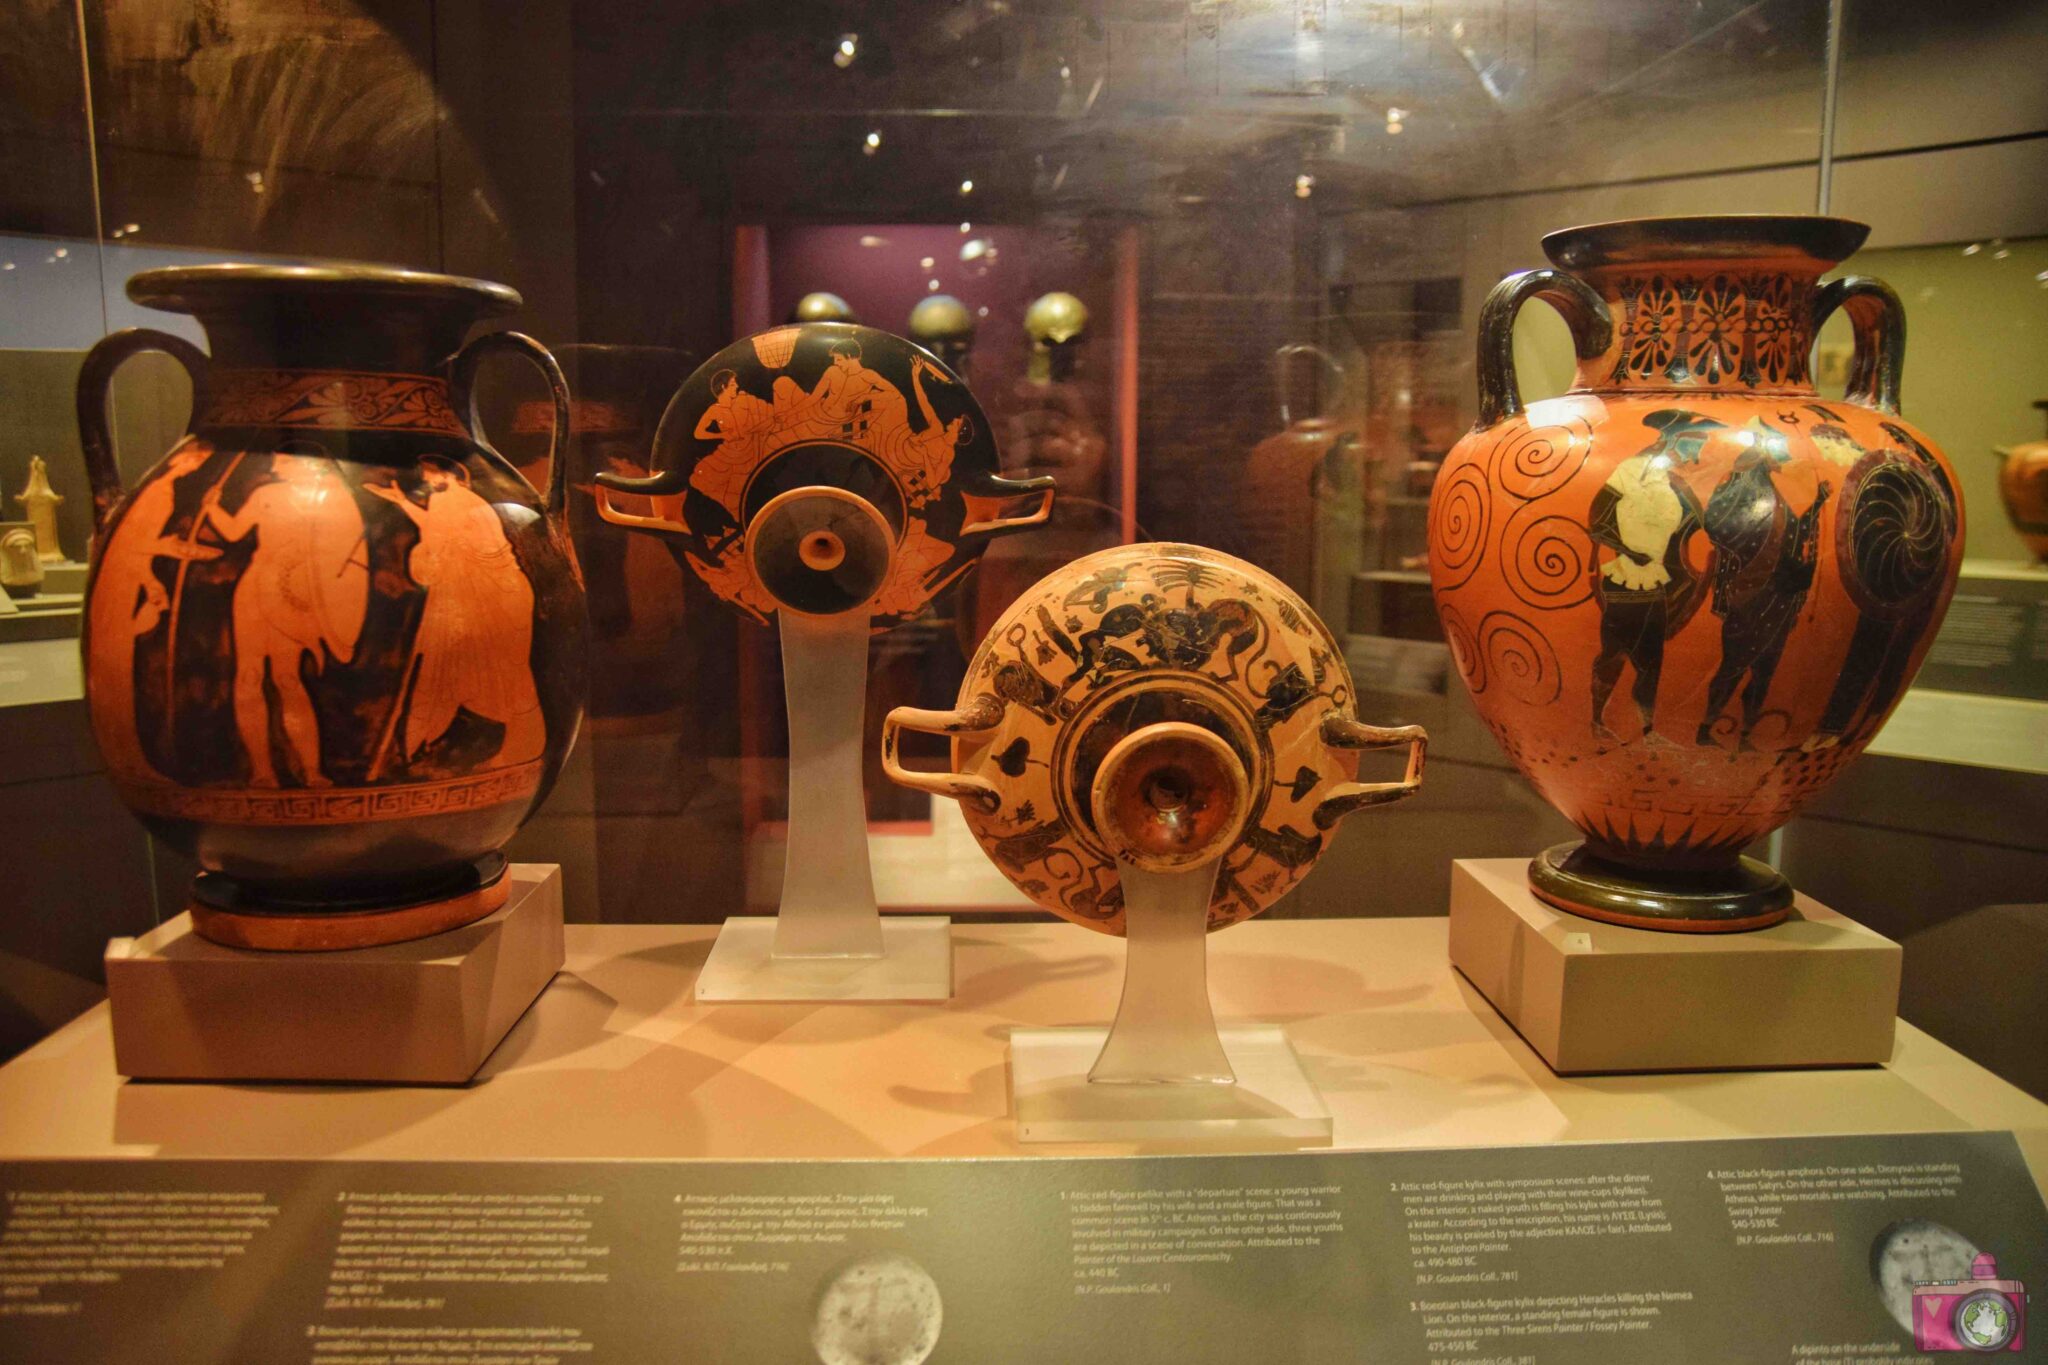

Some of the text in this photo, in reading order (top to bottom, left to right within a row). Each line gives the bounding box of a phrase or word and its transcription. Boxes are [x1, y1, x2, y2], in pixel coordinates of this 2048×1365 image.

[1400, 1181, 1420, 1190] Attic
[1421, 1179, 1464, 1192] red-figure
[1464, 1178, 1484, 1190] kylix
[1485, 1177, 1505, 1187] with
[1505, 1176, 1554, 1189] symposium
[1586, 1174, 1606, 1184] after
[1607, 1173, 1622, 1183] the
[1622, 1172, 1652, 1184] dinner,
[1280, 1187, 1309, 1197] young
[1310, 1184, 1341, 1194] warrior
[1439, 1191, 1475, 1203] drinking
[1475, 1190, 1493, 1200] and
[1493, 1189, 1526, 1202] playing
[1526, 1188, 1546, 1198] with
[1546, 1188, 1567, 1198] their
[1567, 1187, 1611, 1199] wine-cups
[1222, 1199, 1245, 1209] male
[1275, 1198, 1295, 1208] That
[1405, 1206, 1418, 1215] On
[1419, 1205, 1434, 1215] the
[1477, 1203, 1504, 1213] naked
[1504, 1202, 1530, 1214] youth
[1531, 1202, 1539, 1211] is
[1539, 1200, 1564, 1213] filling
[1564, 1200, 1578, 1209] his
[1578, 1199, 1598, 1211] kylix
[1599, 1198, 1618, 1208] with
[1619, 1198, 1640, 1207] wine
[1641, 1197, 1662, 1207] from
[1232, 1211, 1247, 1221] the
[1248, 1211, 1265, 1223] city
[1284, 1209, 1341, 1222] continuously
[1728, 1206, 1785, 1217] Swing Painter.
[1413, 1217, 1442, 1227] krater.
[1442, 1216, 1487, 1229] According
[1487, 1216, 1498, 1225] to
[1498, 1215, 1514, 1225] the
[1514, 1214, 1562, 1226] inscription,
[1563, 1213, 1576, 1222] his
[1576, 1214, 1601, 1222] name
[1602, 1212, 1610, 1221] is
[1732, 1218, 1779, 1228] 540-530 BC
[1208, 1225, 1223, 1234] On
[1224, 1224, 1240, 1234] the
[1240, 1224, 1265, 1234] other
[1287, 1223, 1312, 1233] three
[1312, 1222, 1343, 1234] youths
[1409, 1231, 1422, 1241] his
[1423, 1230, 1454, 1243] beauty
[1454, 1230, 1462, 1239] is
[1463, 1229, 1495, 1241] praised
[1496, 1228, 1508, 1240] by
[1508, 1227, 1524, 1237] the
[1525, 1226, 1564, 1239] adjective
[1627, 1222, 1672, 1233] Attributed
[1246, 1236, 1292, 1246] Attributed
[1293, 1236, 1304, 1245] to
[1305, 1235, 1321, 1245] the
[1412, 1242, 1511, 1255] to the Antiphon Painter.
[1116, 1253, 1131, 1263] the
[1427, 1257, 1463, 1266] 490-480
[1463, 1256, 1477, 1266] BC
[1514, 1296, 1535, 1308] kylix
[1578, 1293, 1616, 1303] Heracles
[1617, 1292, 1644, 1304] killing
[1645, 1291, 1660, 1301] the
[1424, 1314, 1445, 1323] Lion.
[1446, 1313, 1460, 1323] On
[1461, 1312, 1477, 1322] the
[1521, 1309, 1560, 1322] standing
[1561, 1307, 1592, 1318] female
[1592, 1306, 1619, 1319] figure
[1620, 1307, 1628, 1316] is
[1426, 1320, 1652, 1337] Attributed to the Three Sirens Painter / Fossey Painter.
[1465, 1340, 1477, 1350] BC
